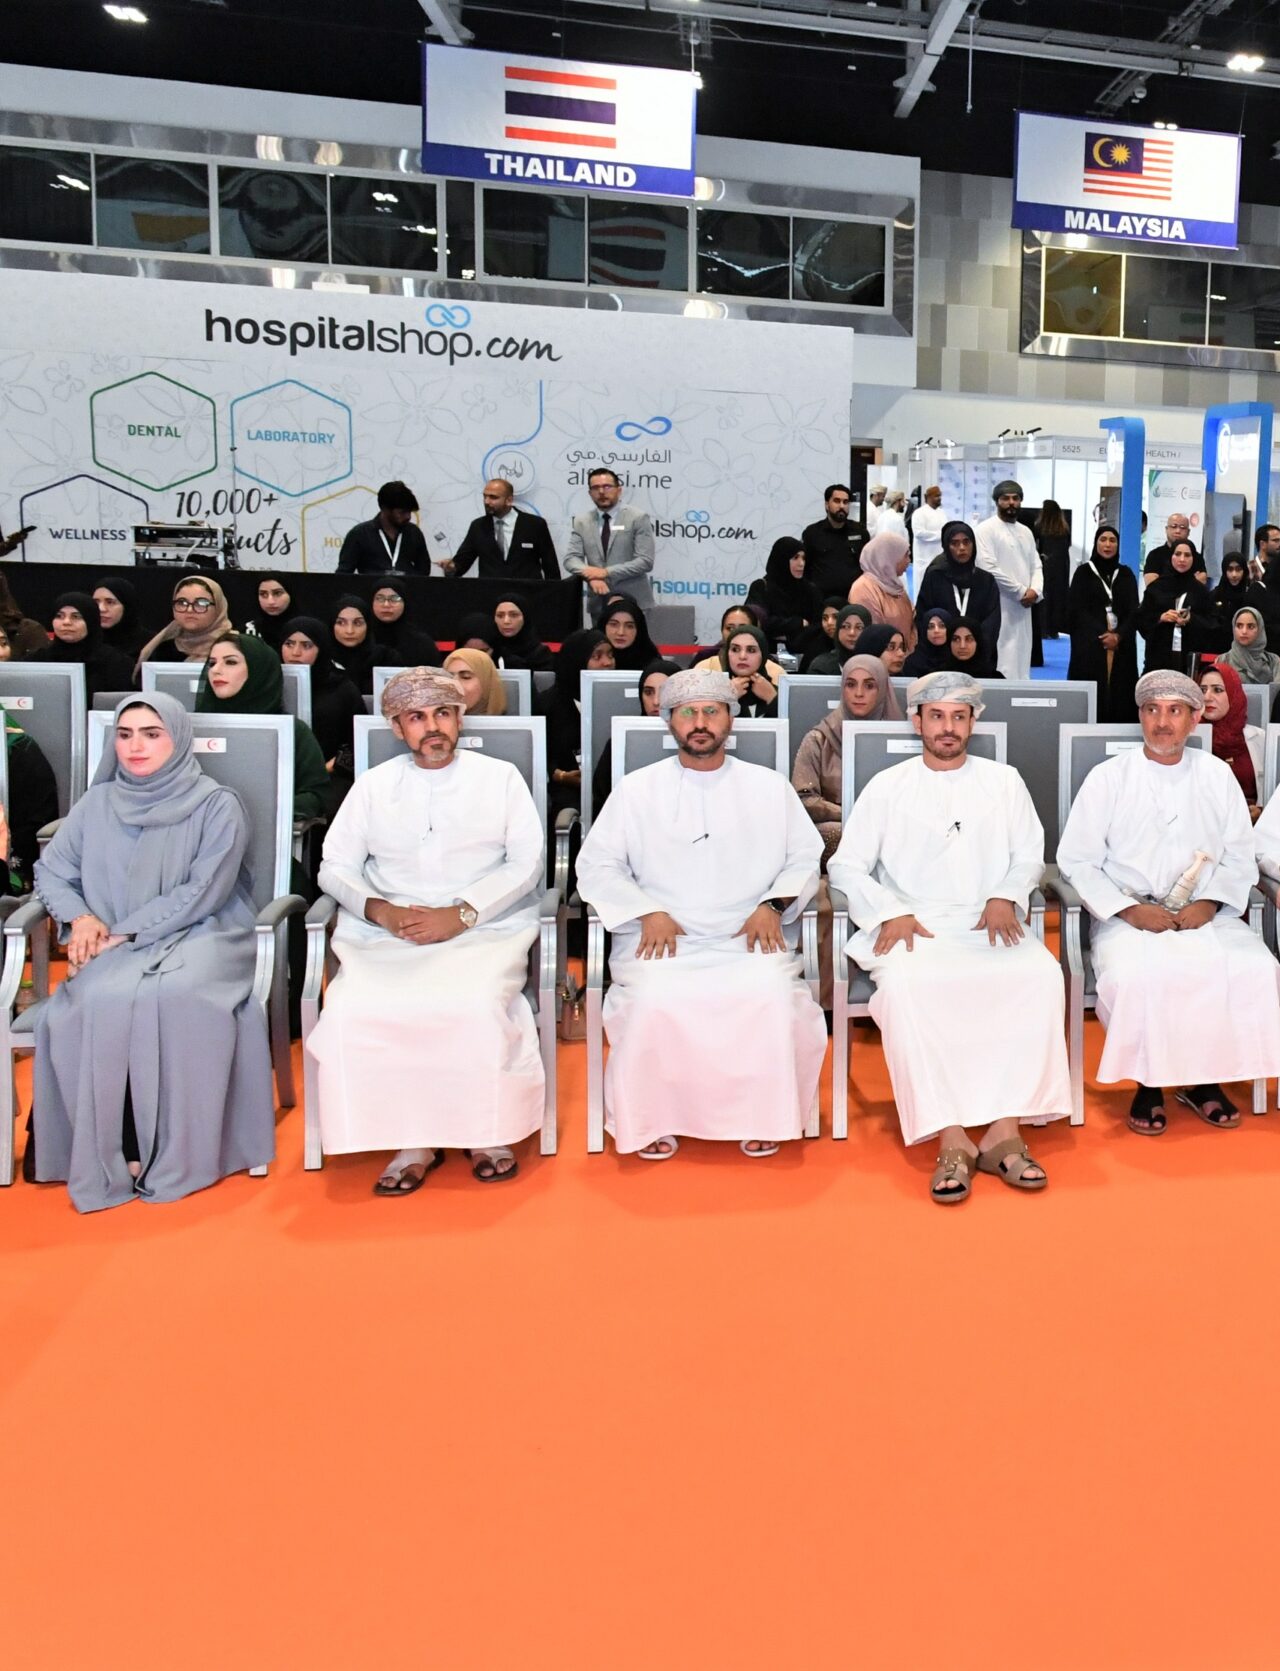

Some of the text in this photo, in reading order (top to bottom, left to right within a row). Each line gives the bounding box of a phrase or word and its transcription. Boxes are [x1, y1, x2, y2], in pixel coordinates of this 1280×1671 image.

[484, 151, 637, 188] THAILAND
[1063, 209, 1186, 240] MALAYSIA
[205, 308, 563, 366] hospitalshop.com
[127, 424, 182, 439] DENTAL
[247, 429, 336, 445] LABORATORY
[567, 468, 672, 490] alsi.me
[176, 488, 279, 518] 10,000+
[49, 527, 127, 541] WELLNESS
